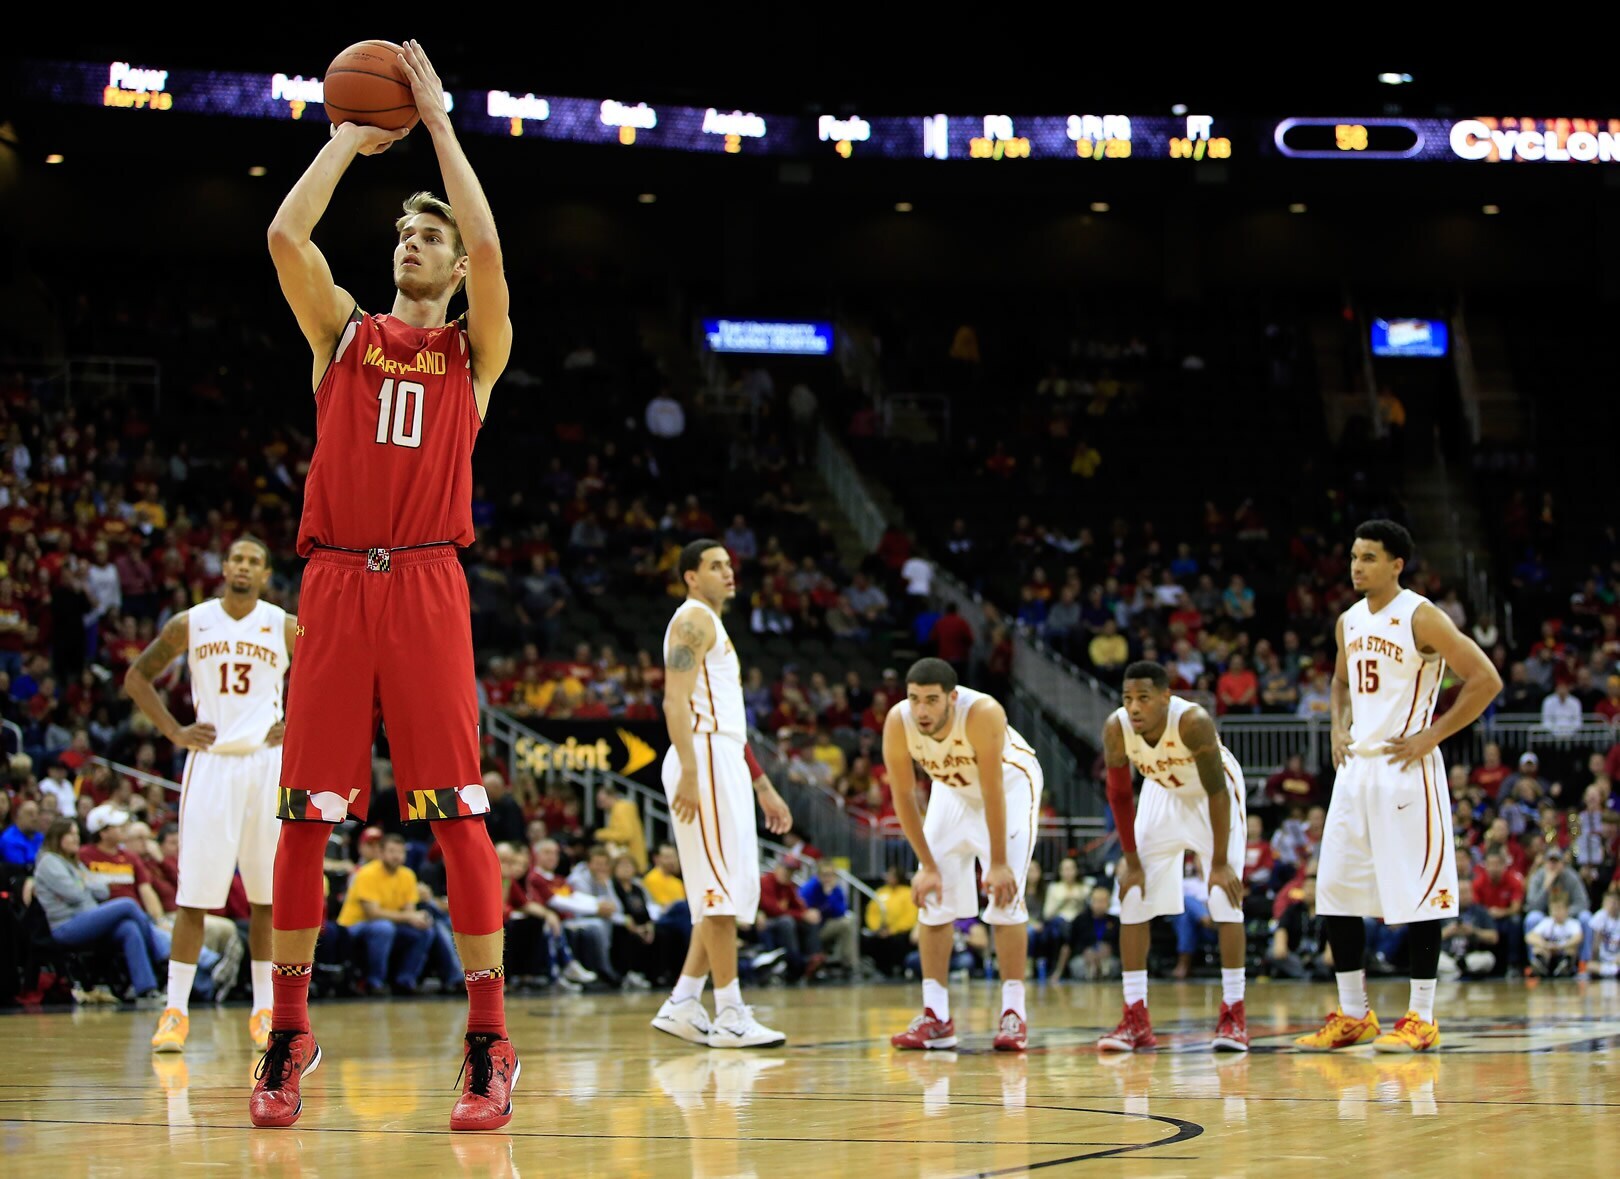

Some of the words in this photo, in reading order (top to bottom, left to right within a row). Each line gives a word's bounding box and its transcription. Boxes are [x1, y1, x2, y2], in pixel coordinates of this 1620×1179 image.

[109, 61, 168, 94] Player
[362, 343, 446, 375] MARYLAND
[375, 378, 425, 448] 10
[195, 640, 230, 663] IOWA
[235, 641, 278, 668] STATE
[1367, 635, 1403, 664] STATE
[219, 662, 252, 695] 13
[1356, 659, 1379, 694] 15
[515, 736, 612, 775] Sprint
